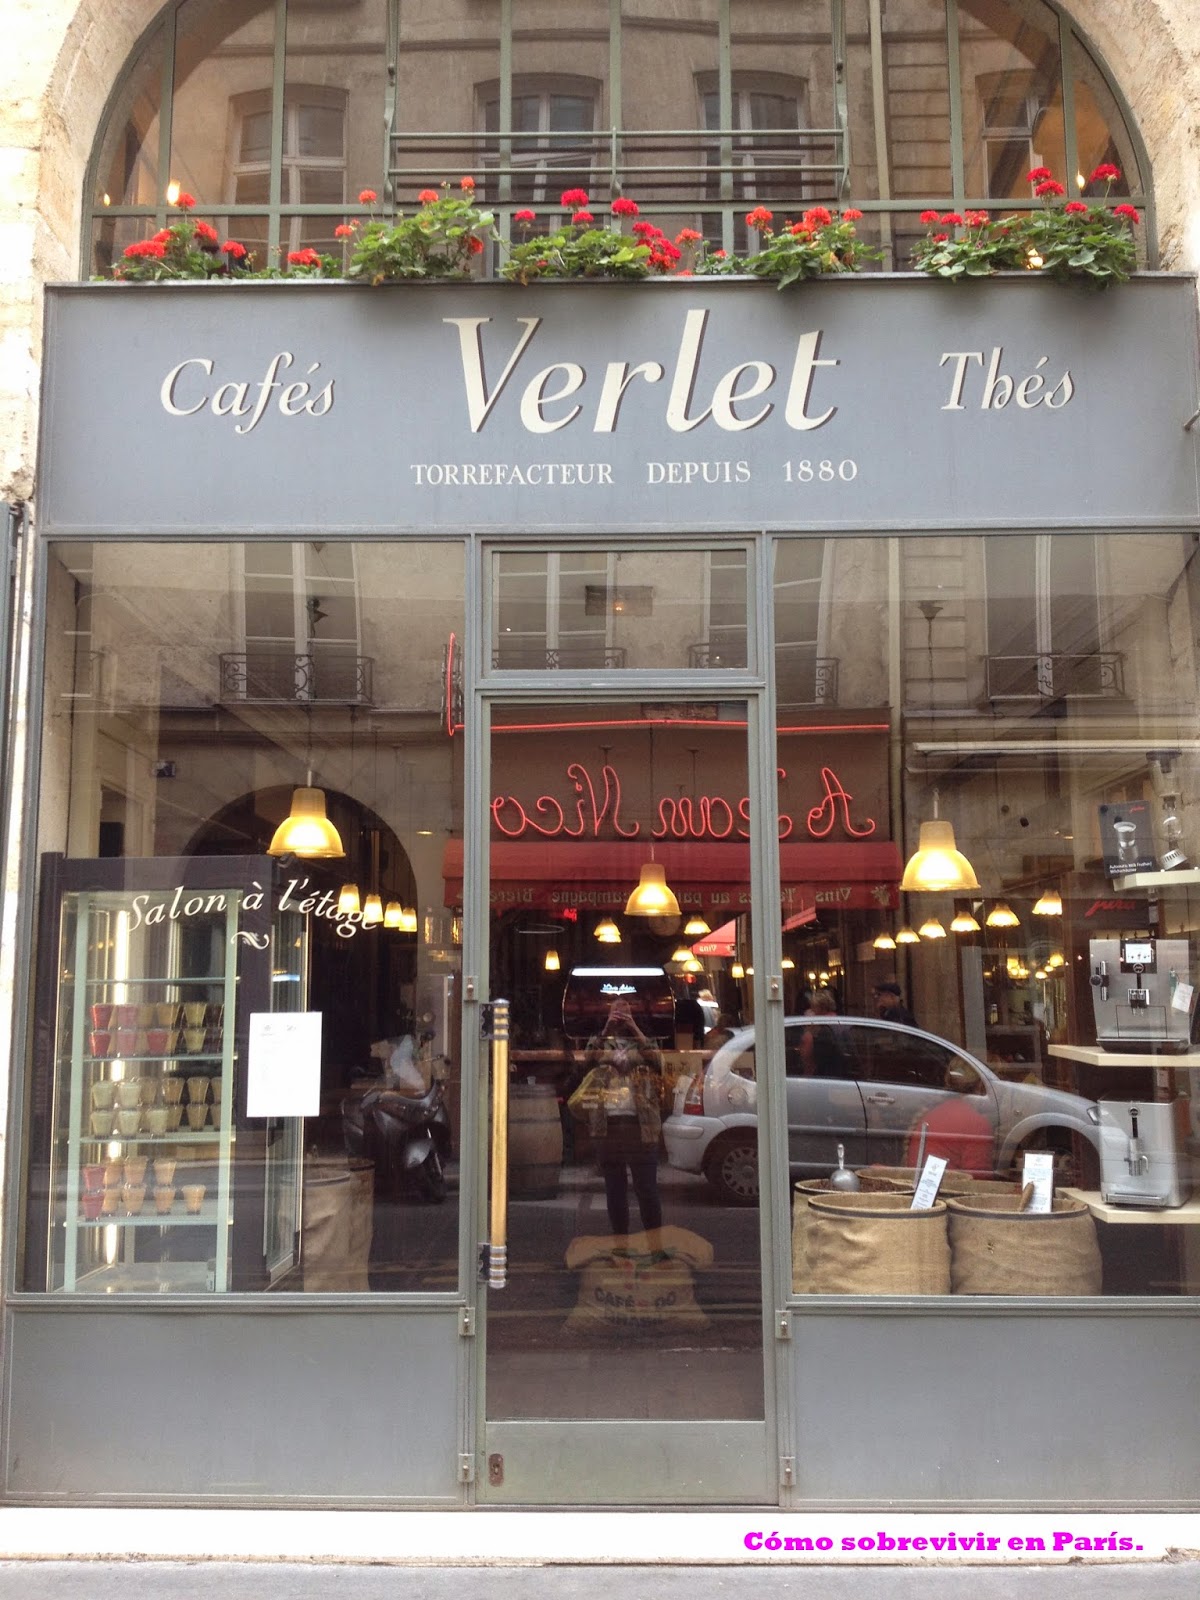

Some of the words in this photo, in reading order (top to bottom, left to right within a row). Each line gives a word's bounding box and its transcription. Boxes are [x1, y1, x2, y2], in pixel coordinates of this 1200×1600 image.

[160, 351, 335, 434] Cafés
[442, 308, 840, 433] Verlet
[938, 346, 1076, 412] Thés
[409, 463, 614, 486] TORREFACTEUR
[647, 461, 752, 485] DEPUIS
[783, 458, 859, 483] 1880
[128, 885, 227, 932] Salon
[241, 881, 265, 911] à
